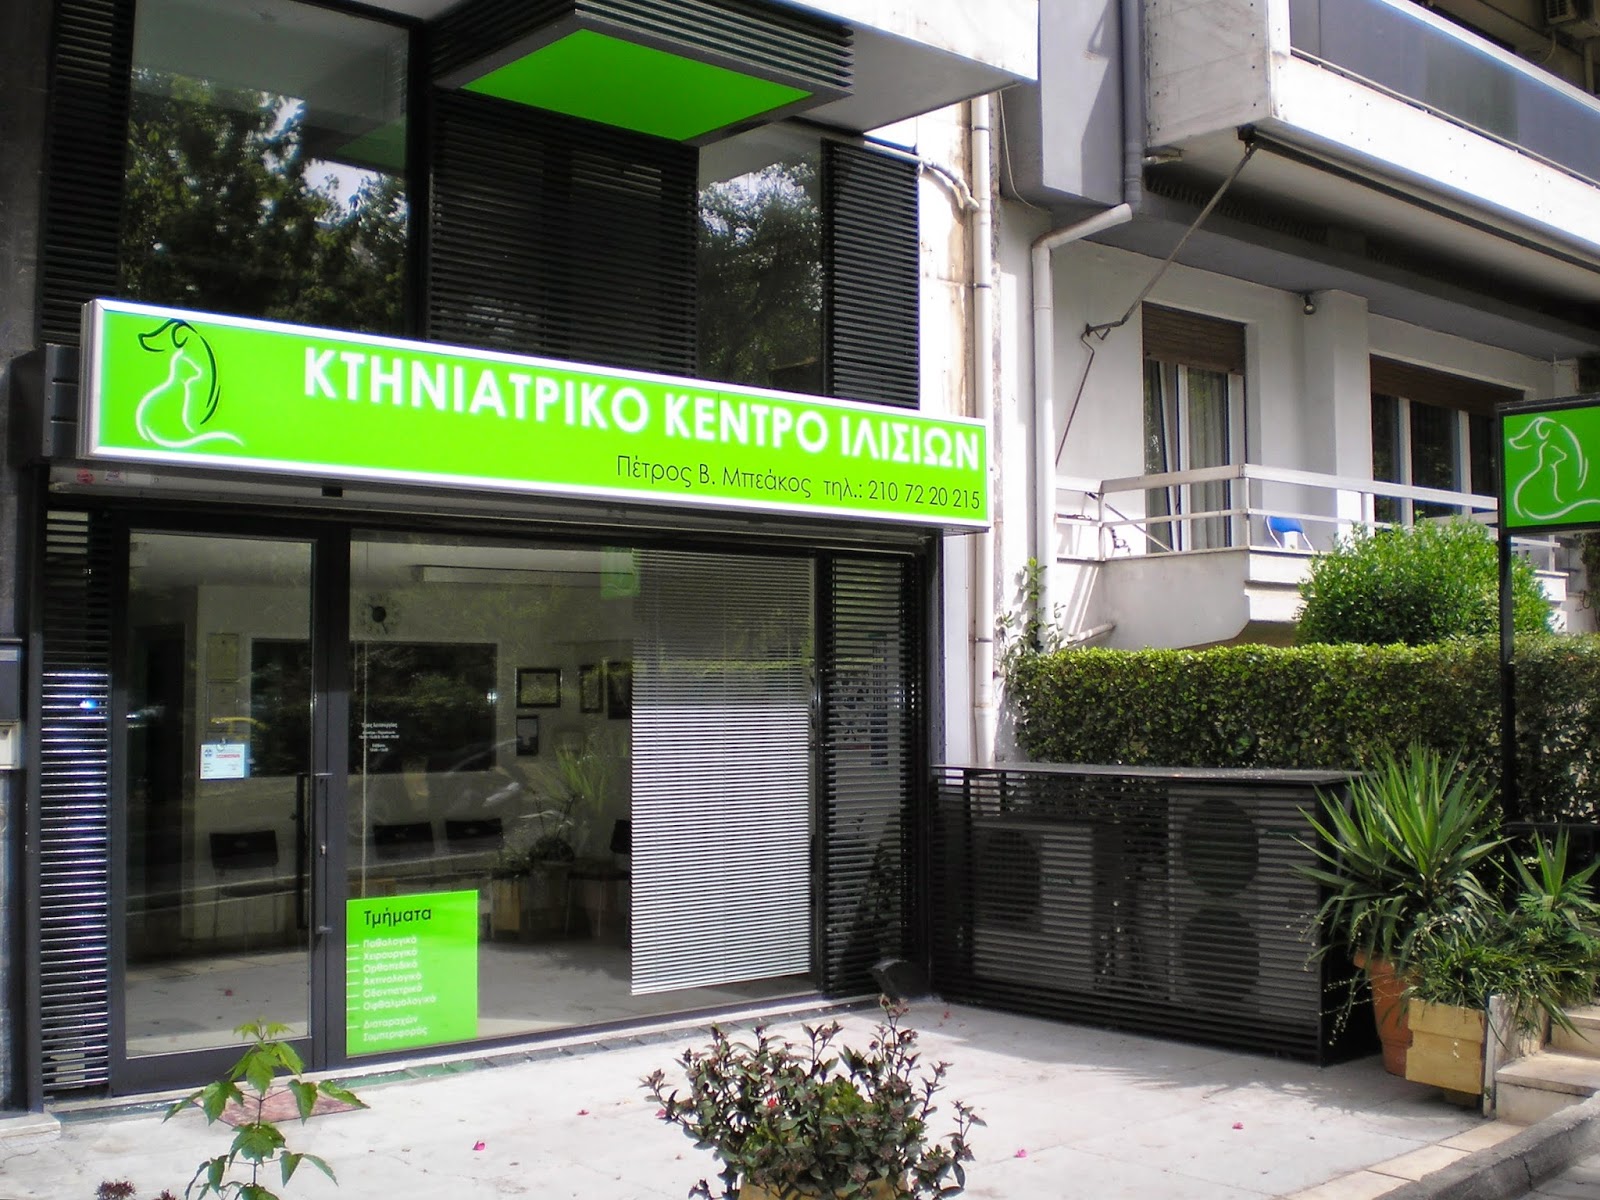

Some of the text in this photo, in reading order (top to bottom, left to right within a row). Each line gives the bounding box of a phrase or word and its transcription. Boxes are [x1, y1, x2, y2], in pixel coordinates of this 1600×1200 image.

[304, 347, 979, 471] ΚΤΗΝΙΑΤΡΙΚΟ ΚΕΝΤΡΟ ΙΛΙΣΙΩΝ
[617, 455, 692, 488] Πέτρος
[699, 463, 716, 485] Β.
[722, 466, 812, 499] Μπεάκος
[868, 480, 898, 502] 210
[905, 484, 924, 504] 72
[929, 487, 948, 506] 20
[953, 489, 980, 509] 215
[364, 907, 432, 928] Τμήματα
[363, 936, 417, 949] Παθολογικό
[363, 948, 418, 961] Χειρουργικό
[363, 960, 418, 974] Ορθοπεδικό
[363, 972, 422, 985] Ακτινολογικό
[363, 995, 437, 1011] Οφθαλμολογικό
